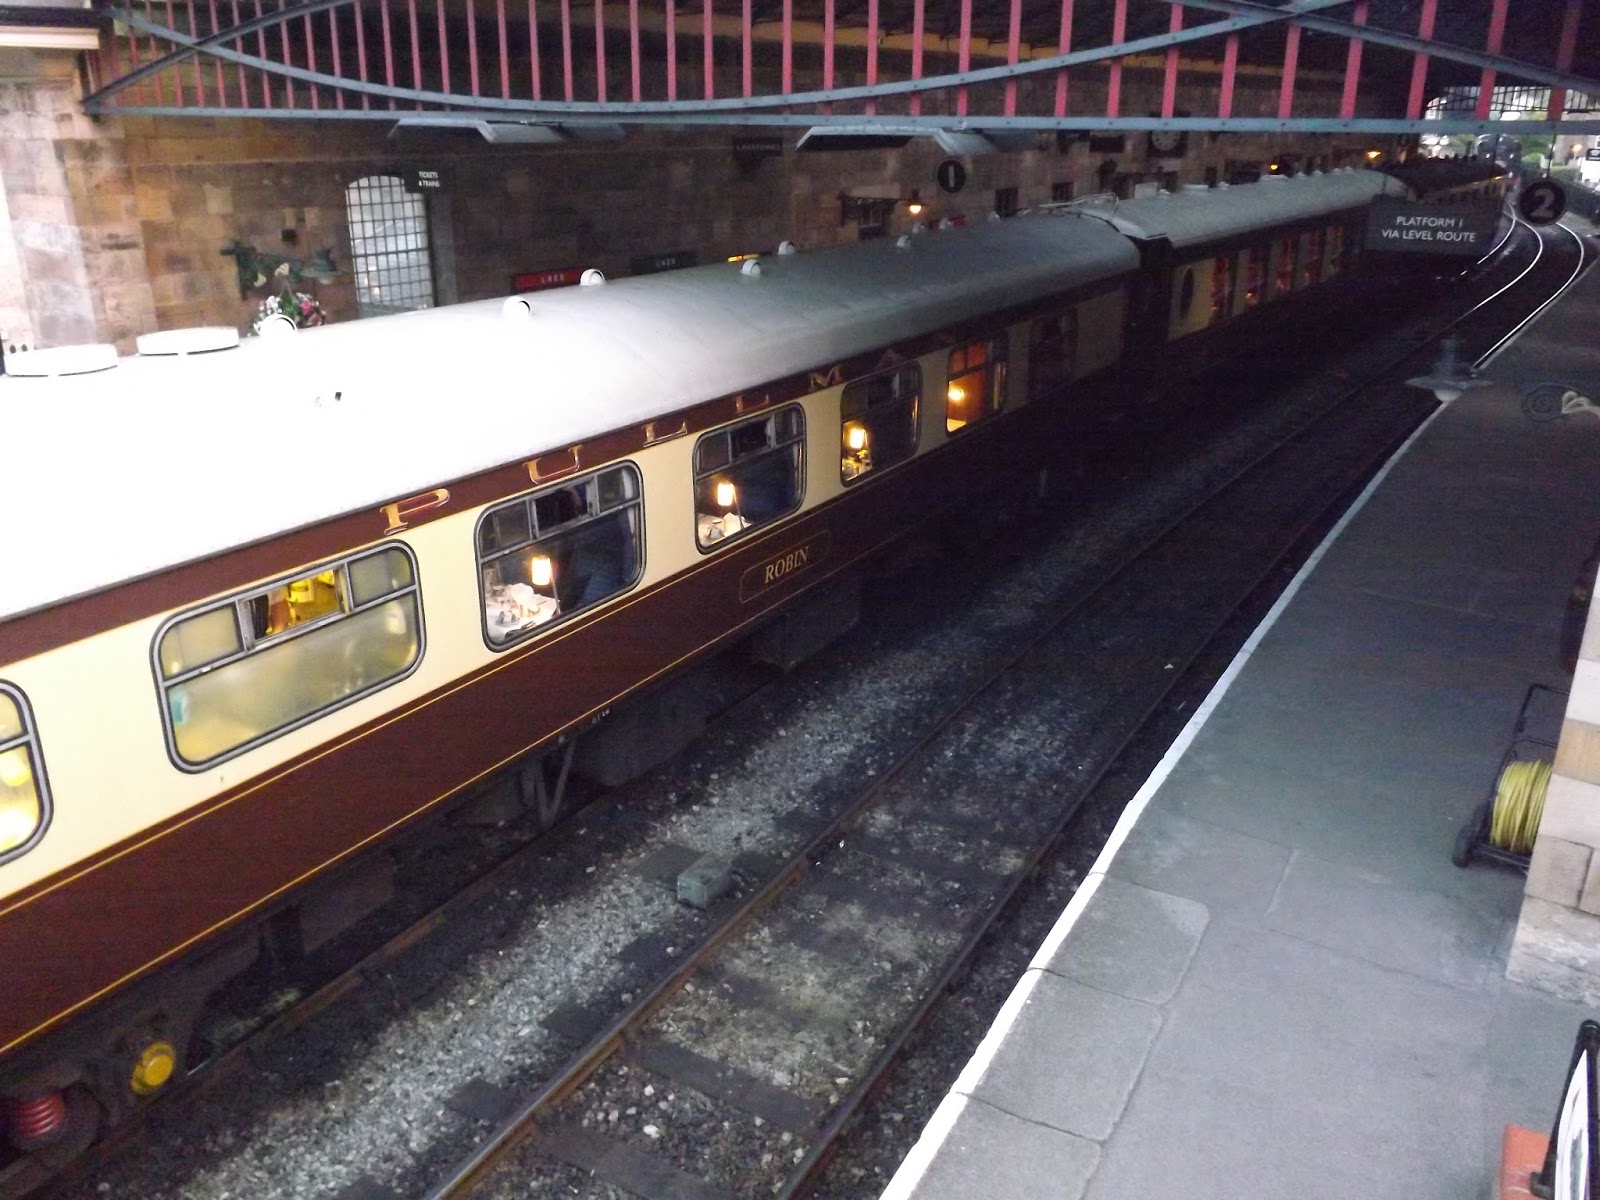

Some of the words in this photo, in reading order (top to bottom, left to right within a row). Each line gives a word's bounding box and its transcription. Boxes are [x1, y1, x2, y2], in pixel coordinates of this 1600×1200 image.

[418, 171, 438, 179] TICKETS
[423, 180, 440, 188] TRAINS
[1531, 188, 1553, 218] 2
[1396, 215, 1455, 228] PLATFORM
[1381, 229, 1399, 239] VIA
[1402, 230, 1433, 241] LEVEL
[1436, 231, 1476, 243] ROUTE
[764, 545, 809, 584] ROBIN
